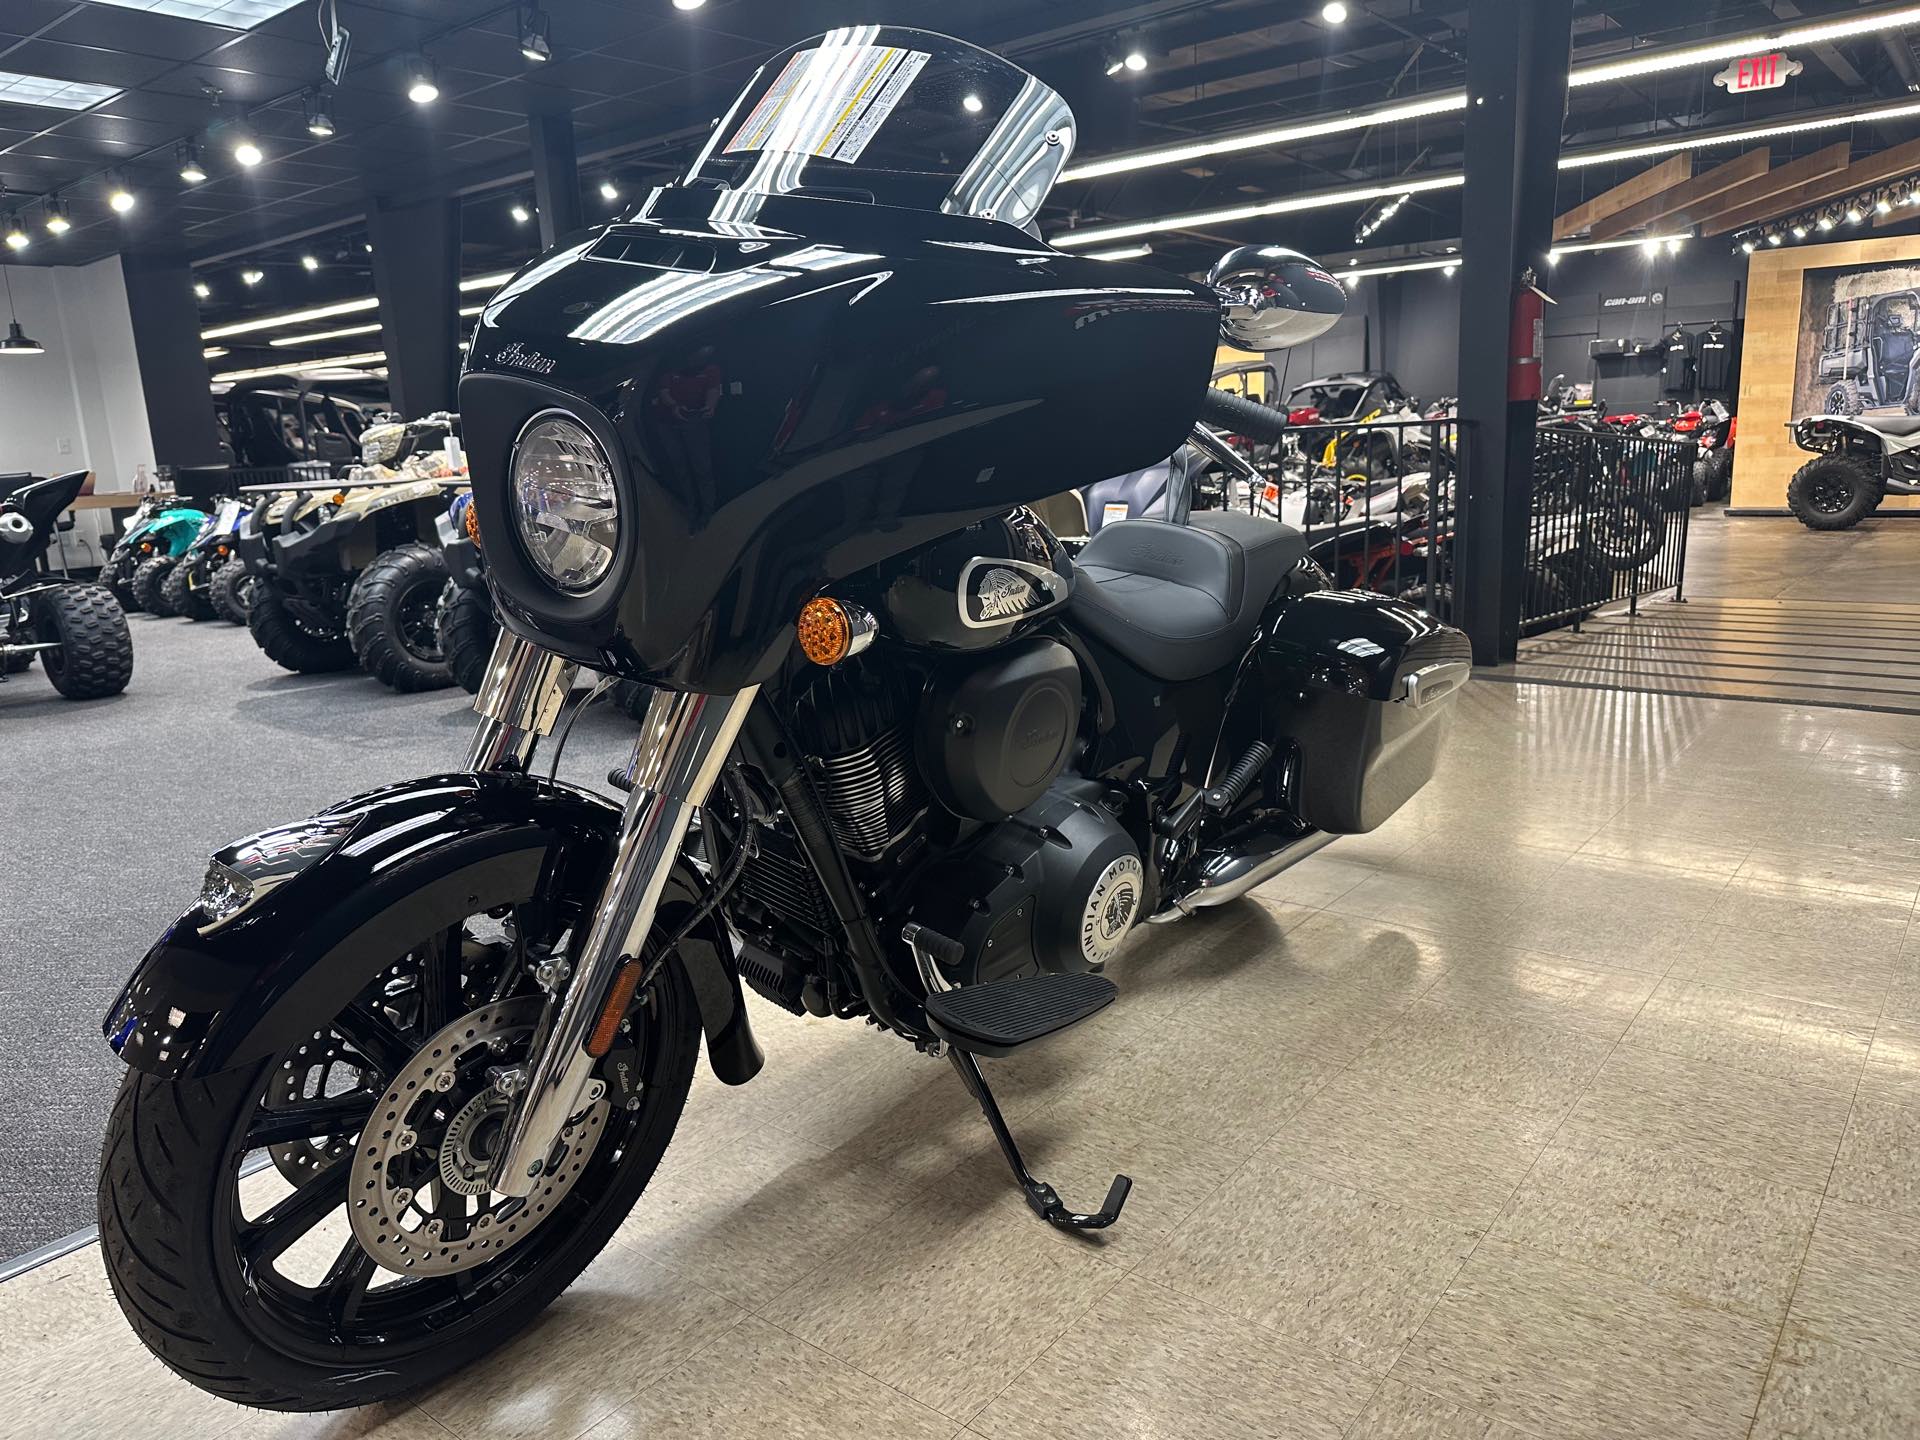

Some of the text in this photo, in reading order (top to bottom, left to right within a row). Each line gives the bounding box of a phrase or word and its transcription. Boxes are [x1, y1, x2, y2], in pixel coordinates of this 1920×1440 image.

[1738, 54, 1781, 89] EXIT
[494, 342, 557, 375] Indian
[1001, 583, 1027, 598] Indian
[1084, 884, 1106, 953] INDIAN
[617, 1062, 630, 1094] Indian
